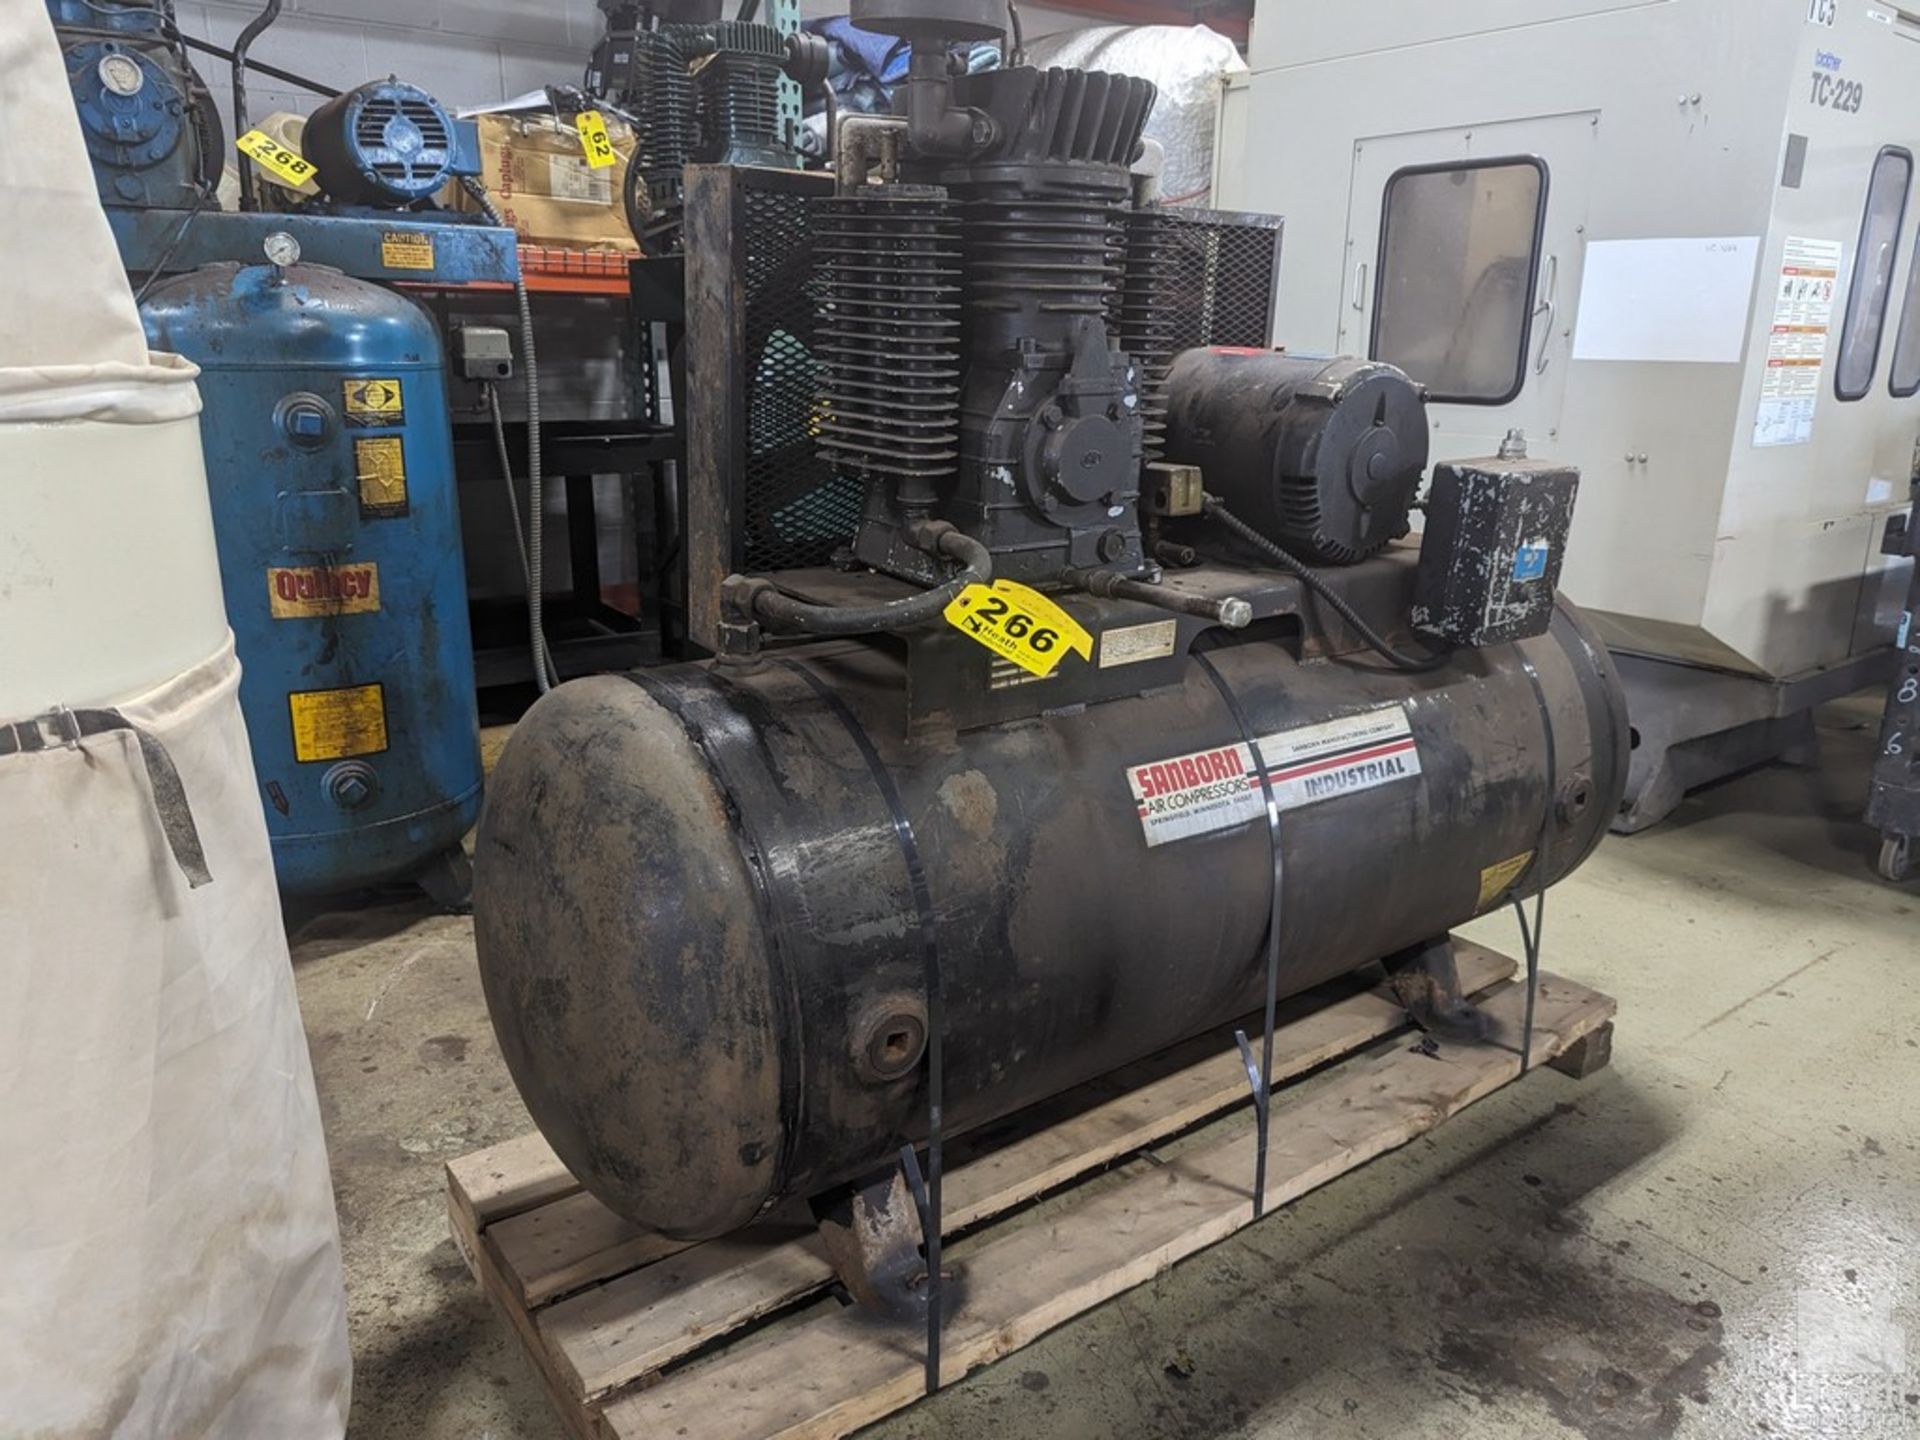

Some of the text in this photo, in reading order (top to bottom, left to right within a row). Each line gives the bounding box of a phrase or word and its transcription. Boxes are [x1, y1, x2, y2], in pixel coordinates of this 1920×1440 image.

[1810, 71, 1863, 114] TC-229
[258, 140, 308, 174] 268
[591, 131, 610, 157] 62
[975, 597, 1060, 653] 266
[983, 626, 1018, 650] Heath
[1369, 723, 1396, 735] COMPANY
[1136, 748, 1245, 799] SANBORN
[1304, 757, 1406, 797] INDUSTRIAL
[1148, 797, 1168, 816] AIR
[1167, 777, 1250, 811] COMPRESSORS
